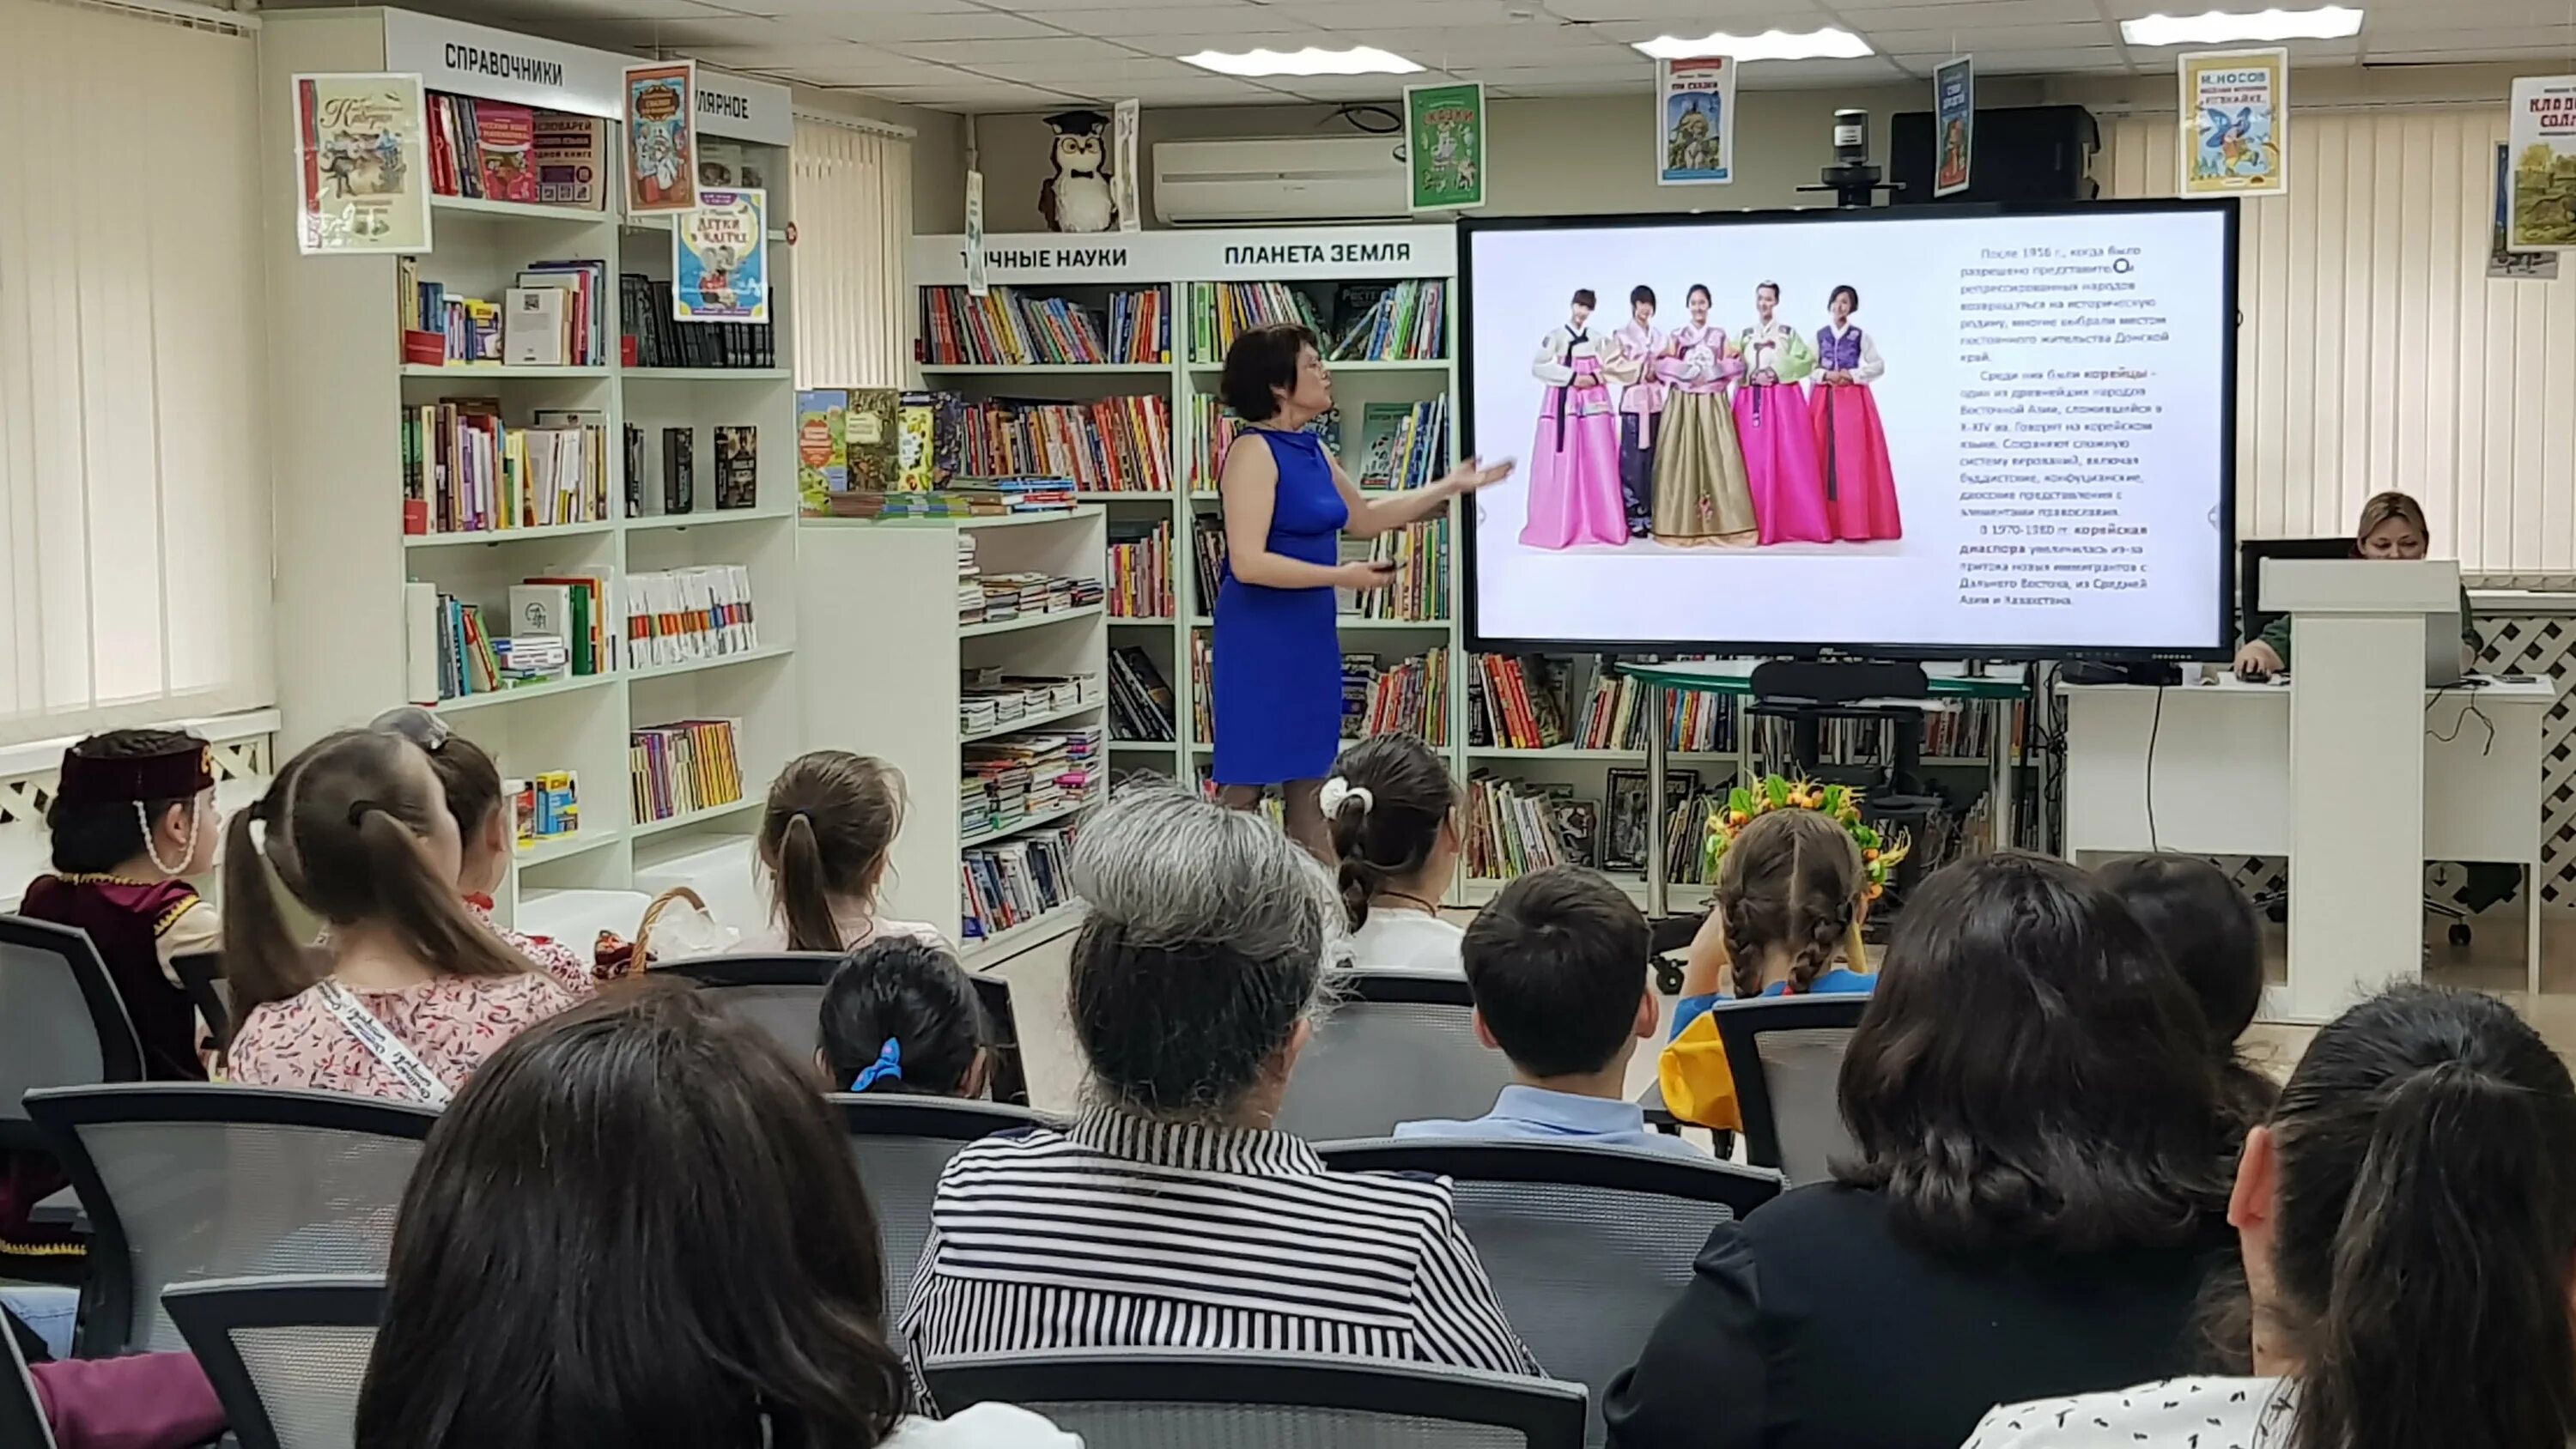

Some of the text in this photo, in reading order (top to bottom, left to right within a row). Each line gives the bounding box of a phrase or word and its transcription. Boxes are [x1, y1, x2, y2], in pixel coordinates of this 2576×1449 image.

[445, 43, 563, 86] СПРАВОЧНИКИ
[696, 89, 750, 119] ЛЯРНОЕ
[2530, 97, 2576, 112] КЛАД
[960, 248, 1127, 270] ТЧНЫЕ НАУКИ
[1224, 243, 1411, 264] ПЛАНЕТА ЗЕМЛЯ
